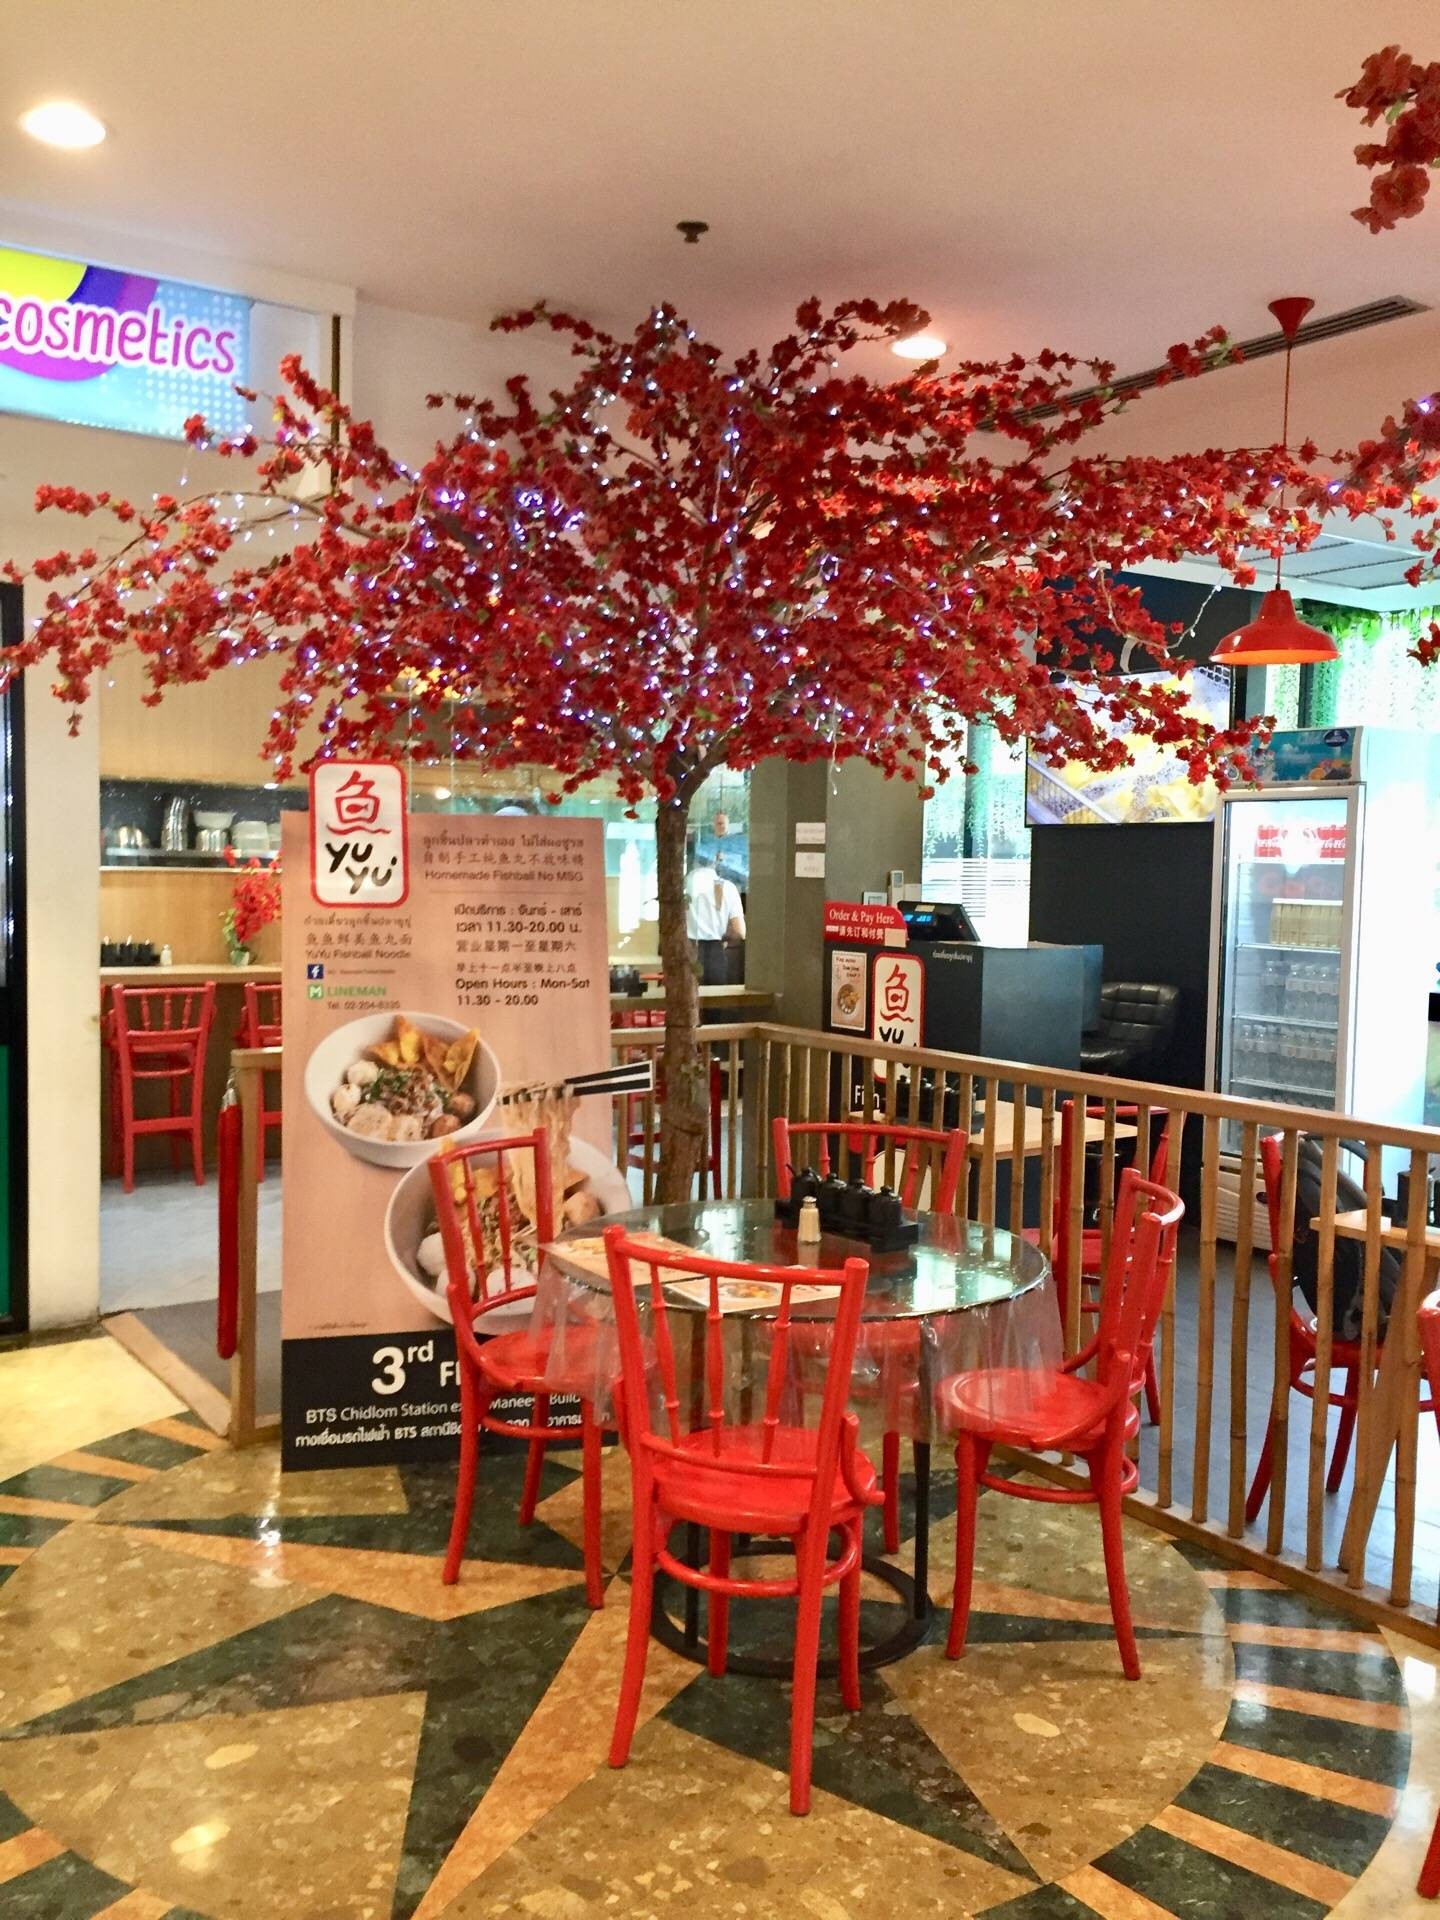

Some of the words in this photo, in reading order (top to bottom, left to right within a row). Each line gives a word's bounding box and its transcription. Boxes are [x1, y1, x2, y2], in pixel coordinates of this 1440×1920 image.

[425, 870, 490, 881] Homemade
[492, 870, 535, 881] Fishball
[537, 871, 553, 882] No
[556, 871, 584, 882] MSG
[829, 908, 850, 921] Order
[860, 911, 874, 926] Pay
[876, 912, 895, 924] Here
[456, 921, 482, 933] เวลา
[488, 921, 565, 933] 11.30-20.00
[455, 978, 489, 991] Open
[493, 978, 528, 989] Hours
[540, 978, 590, 989] Mon-Sat
[457, 994, 491, 1006] 11.30
[505, 994, 539, 1006] 20.00
[306, 1407, 337, 1424] BTS
[340, 1405, 398, 1421] Chidlom
[401, 1402, 448, 1417] Station
[394, 1425, 417, 1440] BTS
